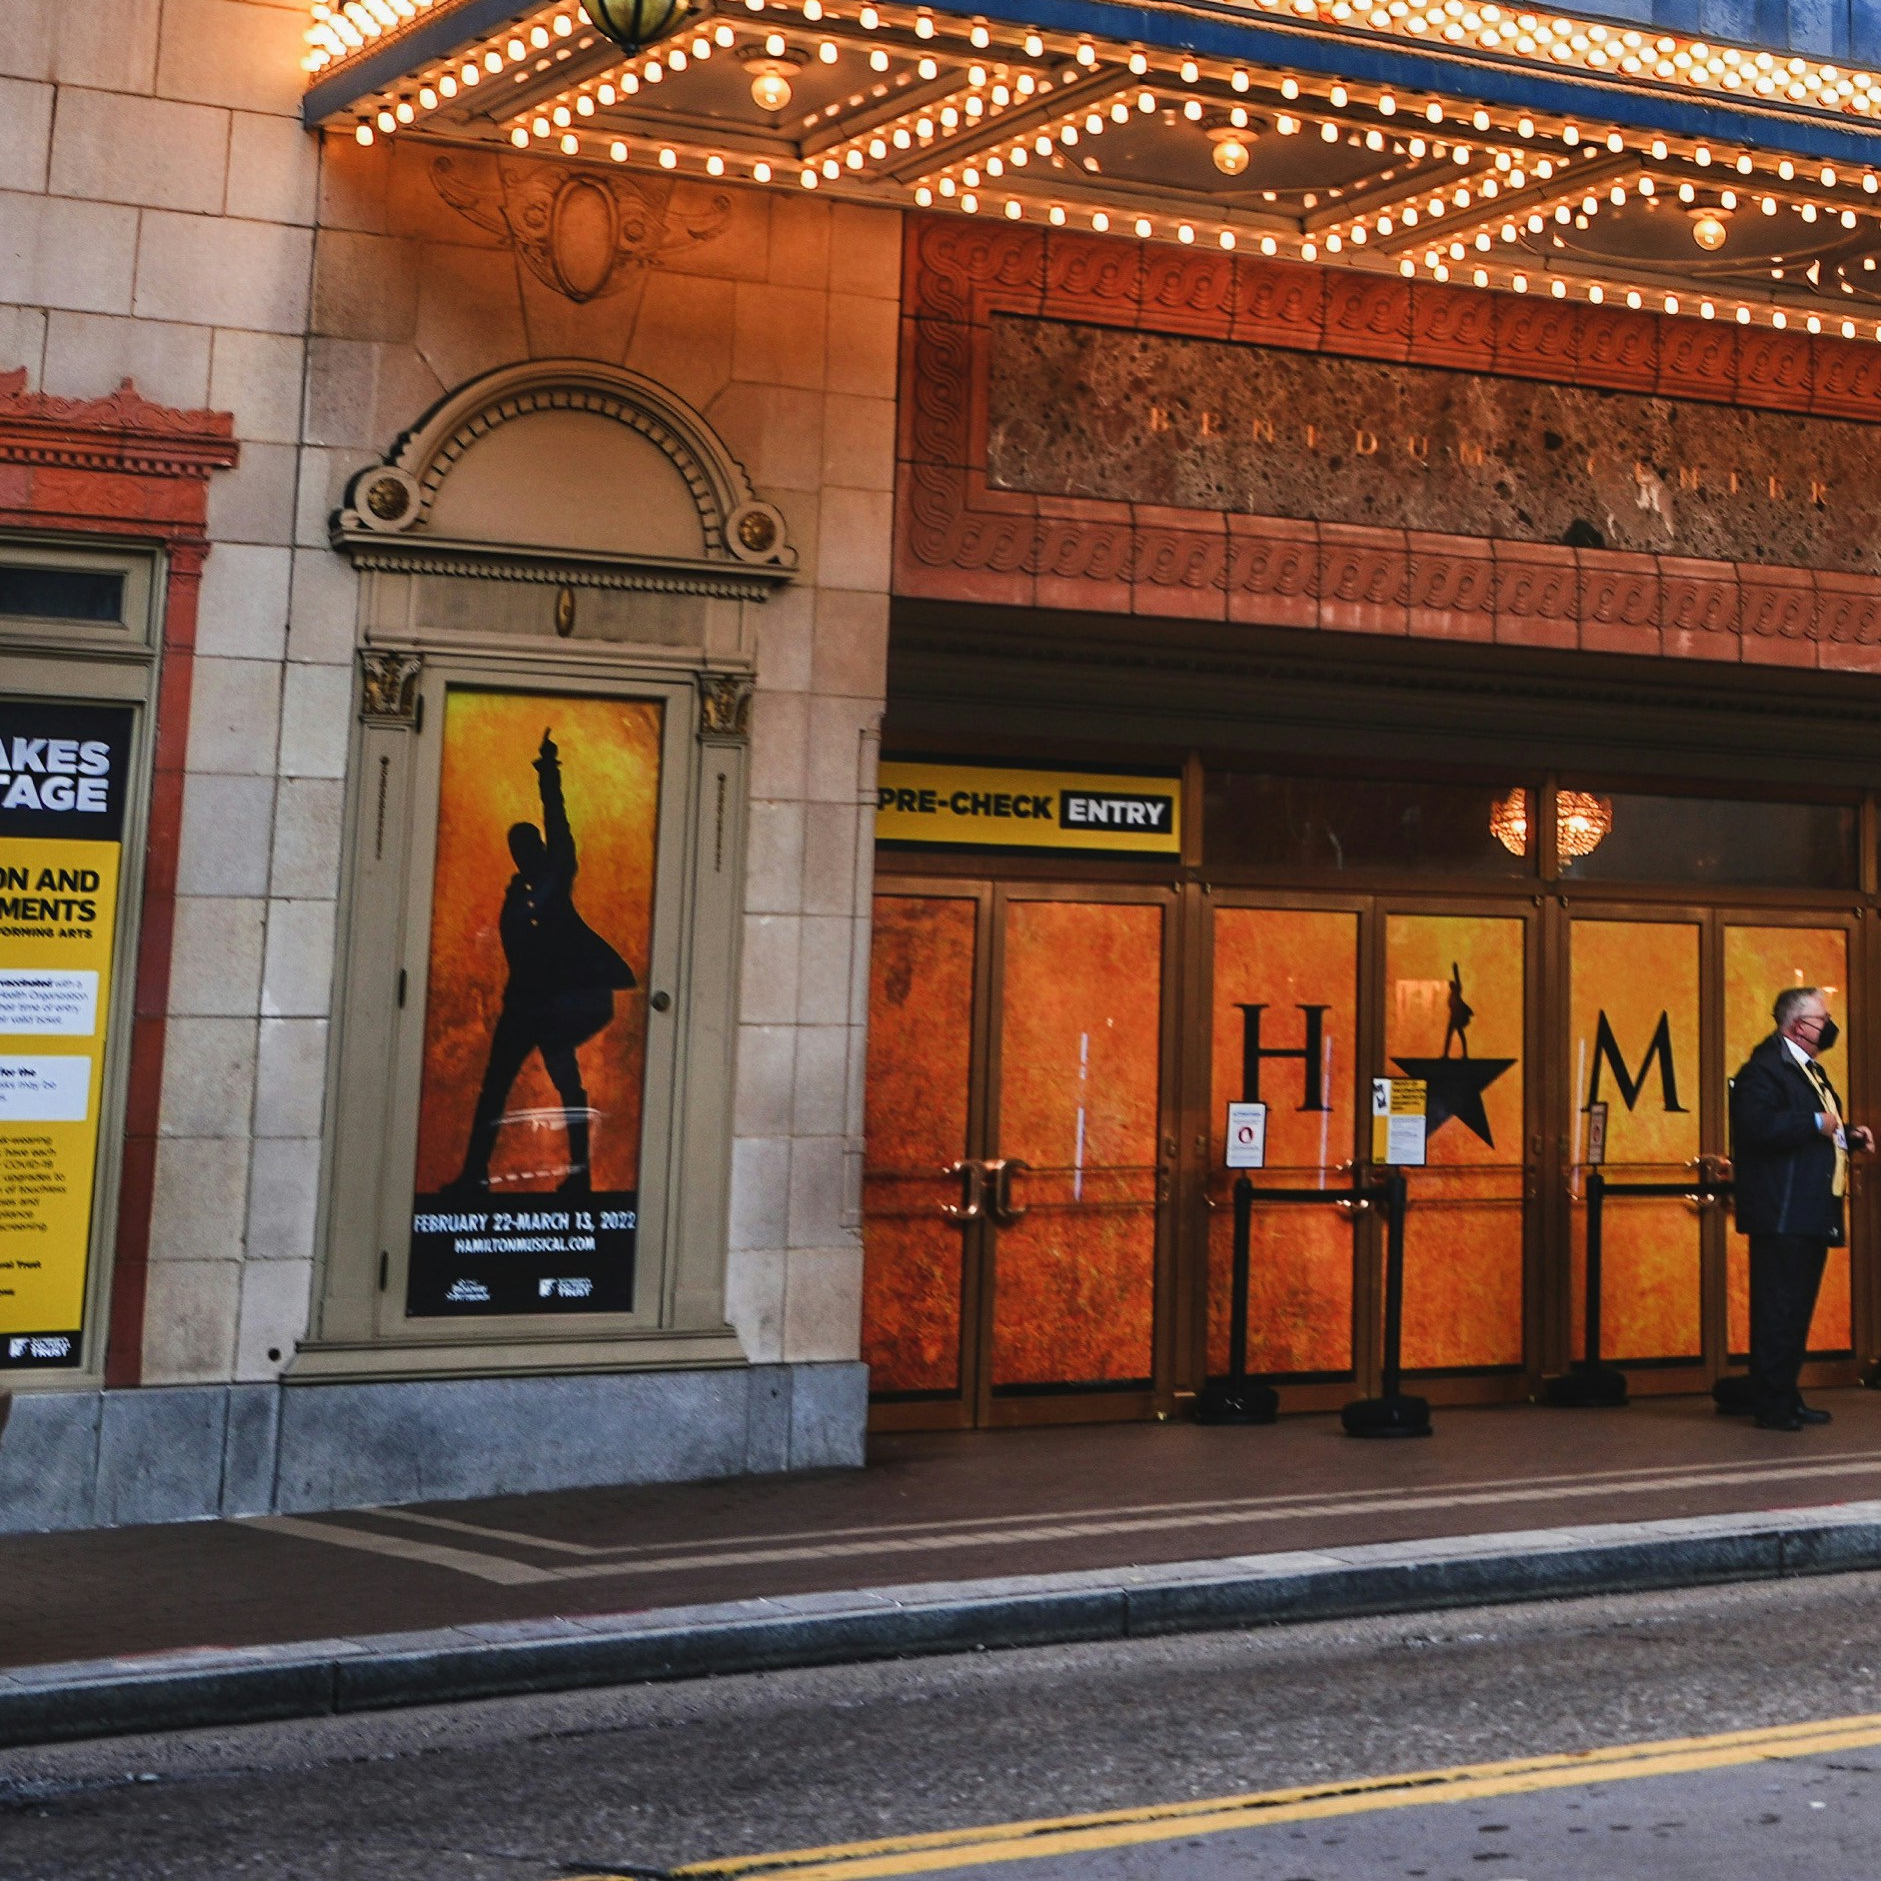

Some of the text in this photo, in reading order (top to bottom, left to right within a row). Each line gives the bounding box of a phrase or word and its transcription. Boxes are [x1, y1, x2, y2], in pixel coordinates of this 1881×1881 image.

[877, 787, 1166, 827] PRE-CHECK ENTRY
[36, 868, 101, 894] AND
[58, 928, 93, 939] ARTS
[413, 1210, 637, 1234] FEBRUARY 22-MARCH 13, 2022
[453, 1235, 597, 1254] HAMILTONMUSICAL.COM
